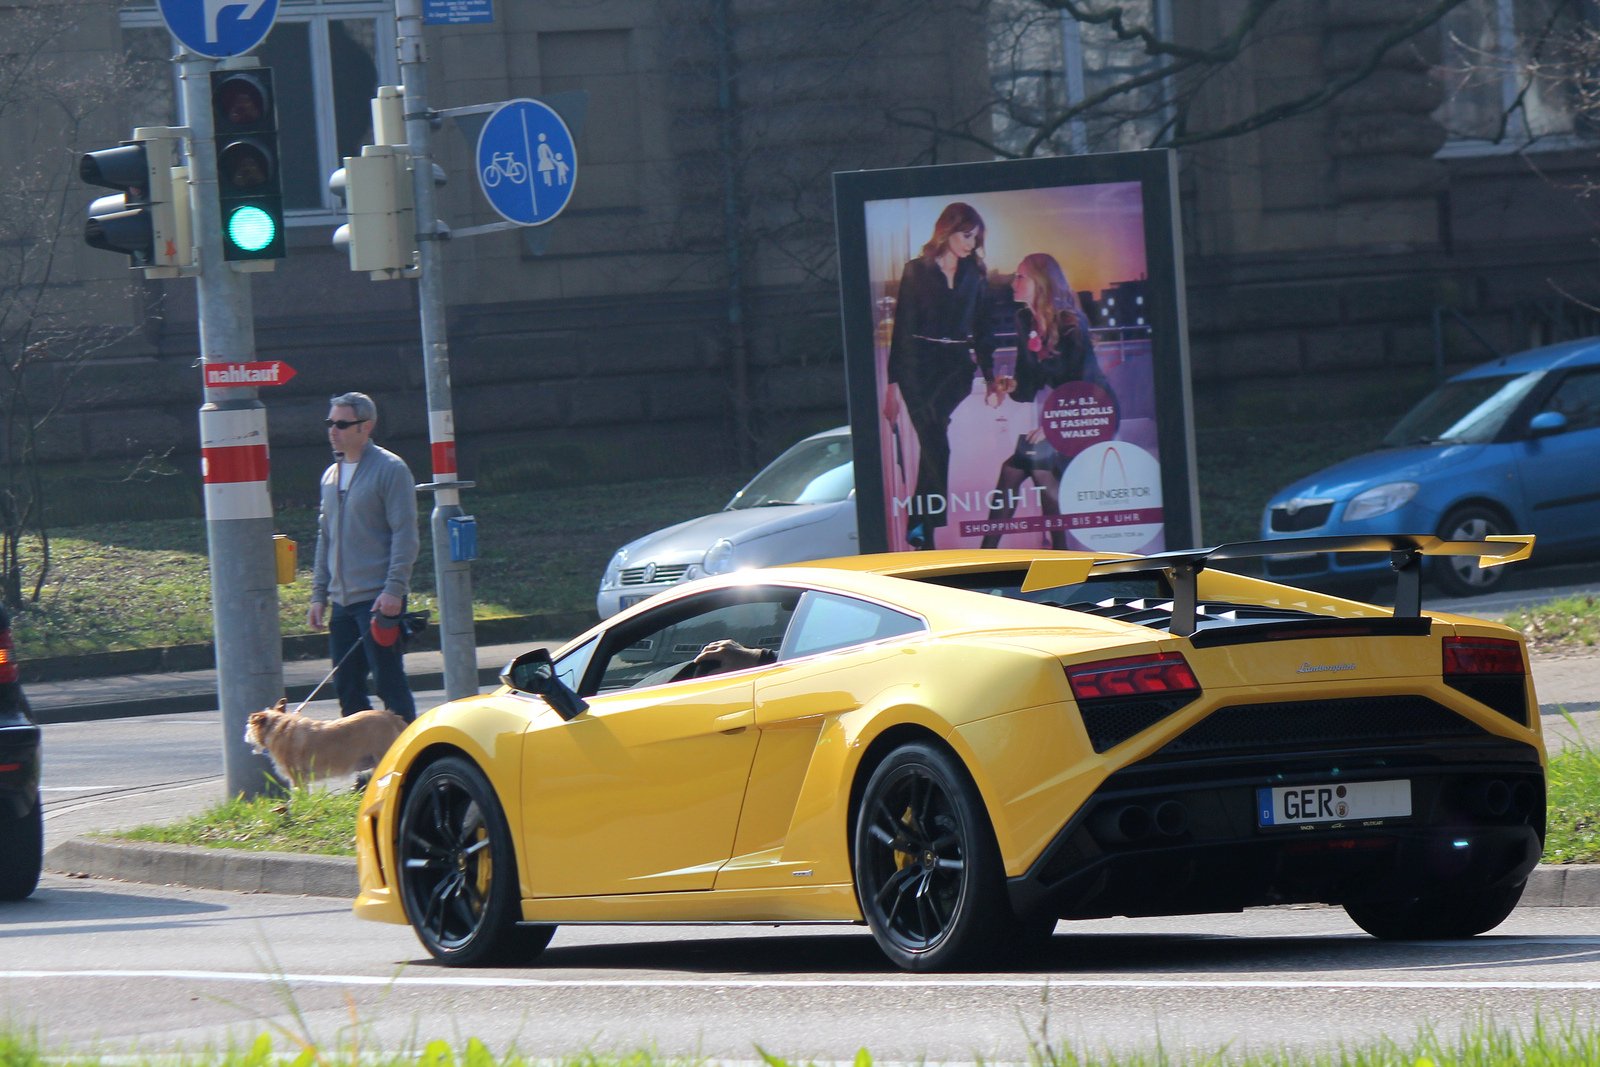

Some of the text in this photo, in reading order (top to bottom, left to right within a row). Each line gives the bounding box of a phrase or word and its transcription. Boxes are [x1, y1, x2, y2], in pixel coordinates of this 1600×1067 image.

[207, 364, 279, 383] nahkauf
[1079, 397, 1098, 405] 8.3.
[1044, 406, 1113, 418] LIVING DOLLS
[1050, 417, 1109, 429] & FASHION
[1061, 429, 1100, 438] WALKS
[1077, 486, 1151, 501] ETTLINGER TOR
[892, 486, 1047, 517] MIDNIGHT
[965, 521, 1028, 534] SHOPPING
[1072, 516, 1090, 526] BIS
[1096, 515, 1109, 524] 24
[1114, 513, 1140, 523] UHR
[1263, 788, 1334, 819] D GER
